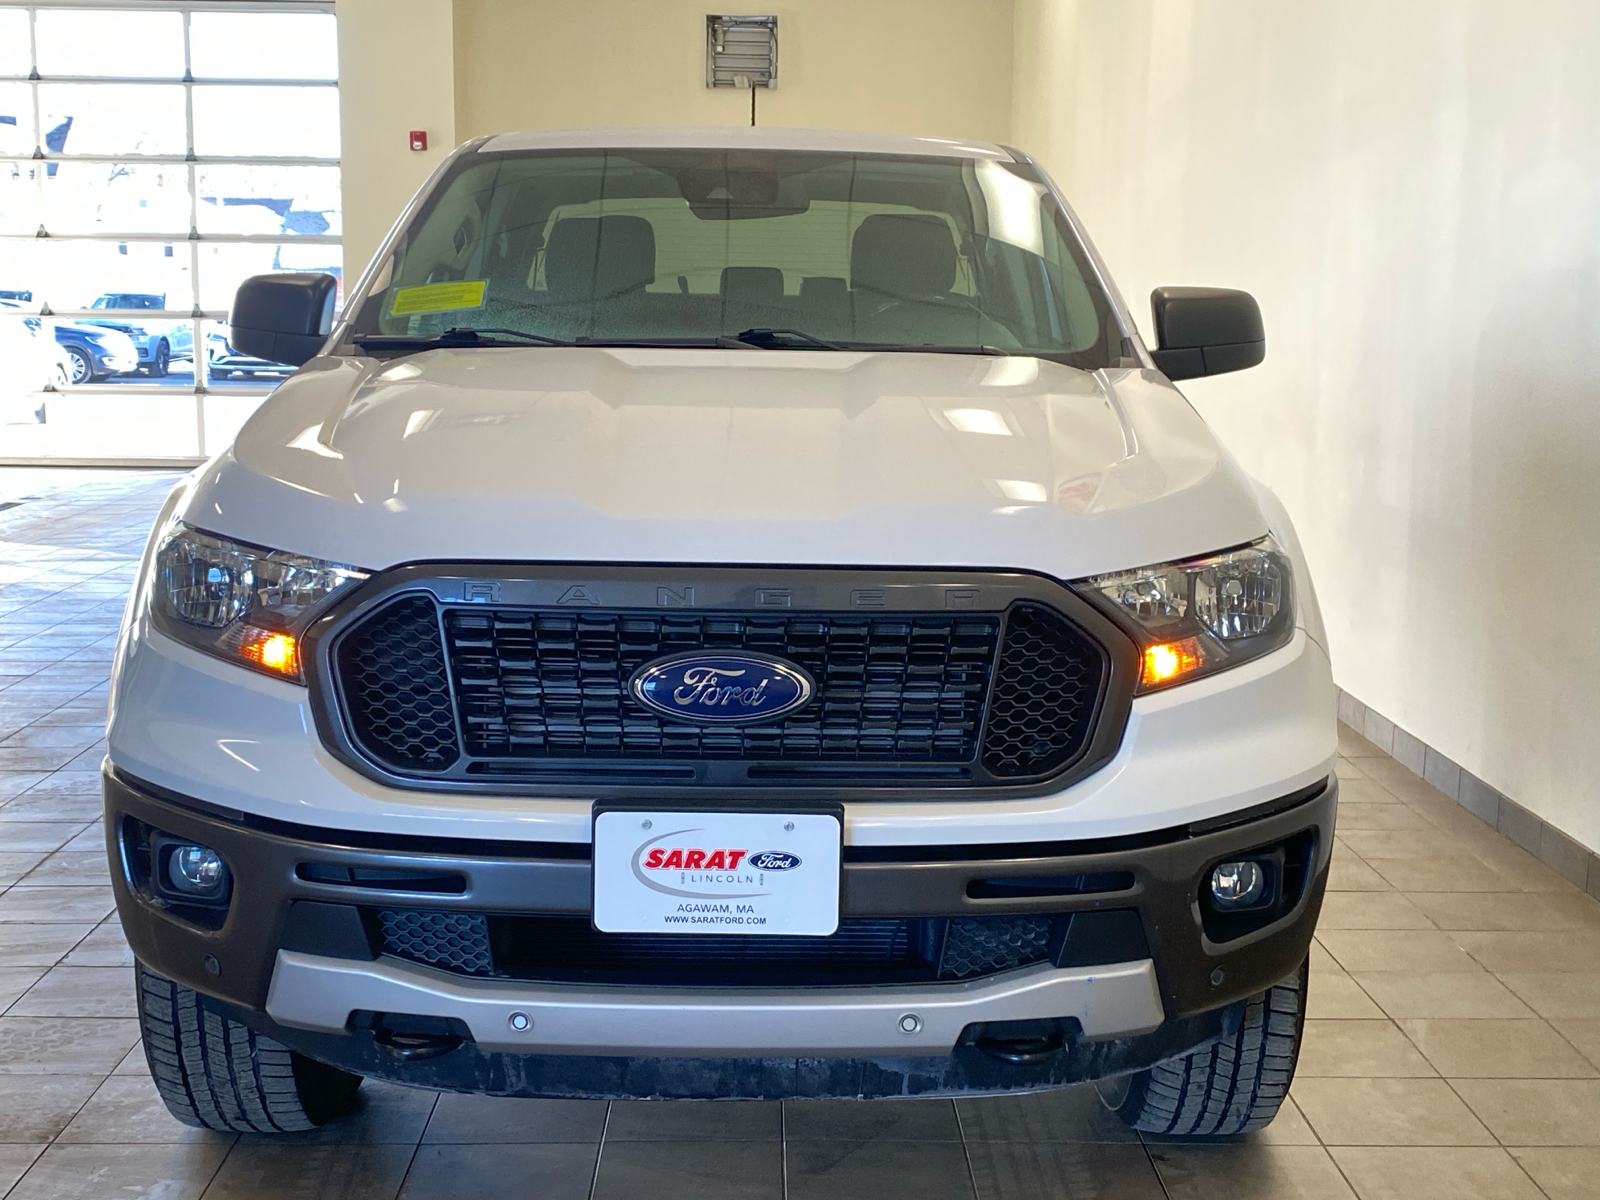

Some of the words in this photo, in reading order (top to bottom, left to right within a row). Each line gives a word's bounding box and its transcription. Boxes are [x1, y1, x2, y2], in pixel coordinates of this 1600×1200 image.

[463, 581, 982, 609] RANGER
[672, 666, 768, 706] Ford
[643, 847, 748, 871] SARAT
[757, 854, 792, 869] Ford
[691, 874, 754, 884] LINCOLN
[676, 903, 733, 915] AGAWAM,
[736, 904, 755, 914] MA
[664, 915, 767, 925] WWW.SARATFORD.COM
